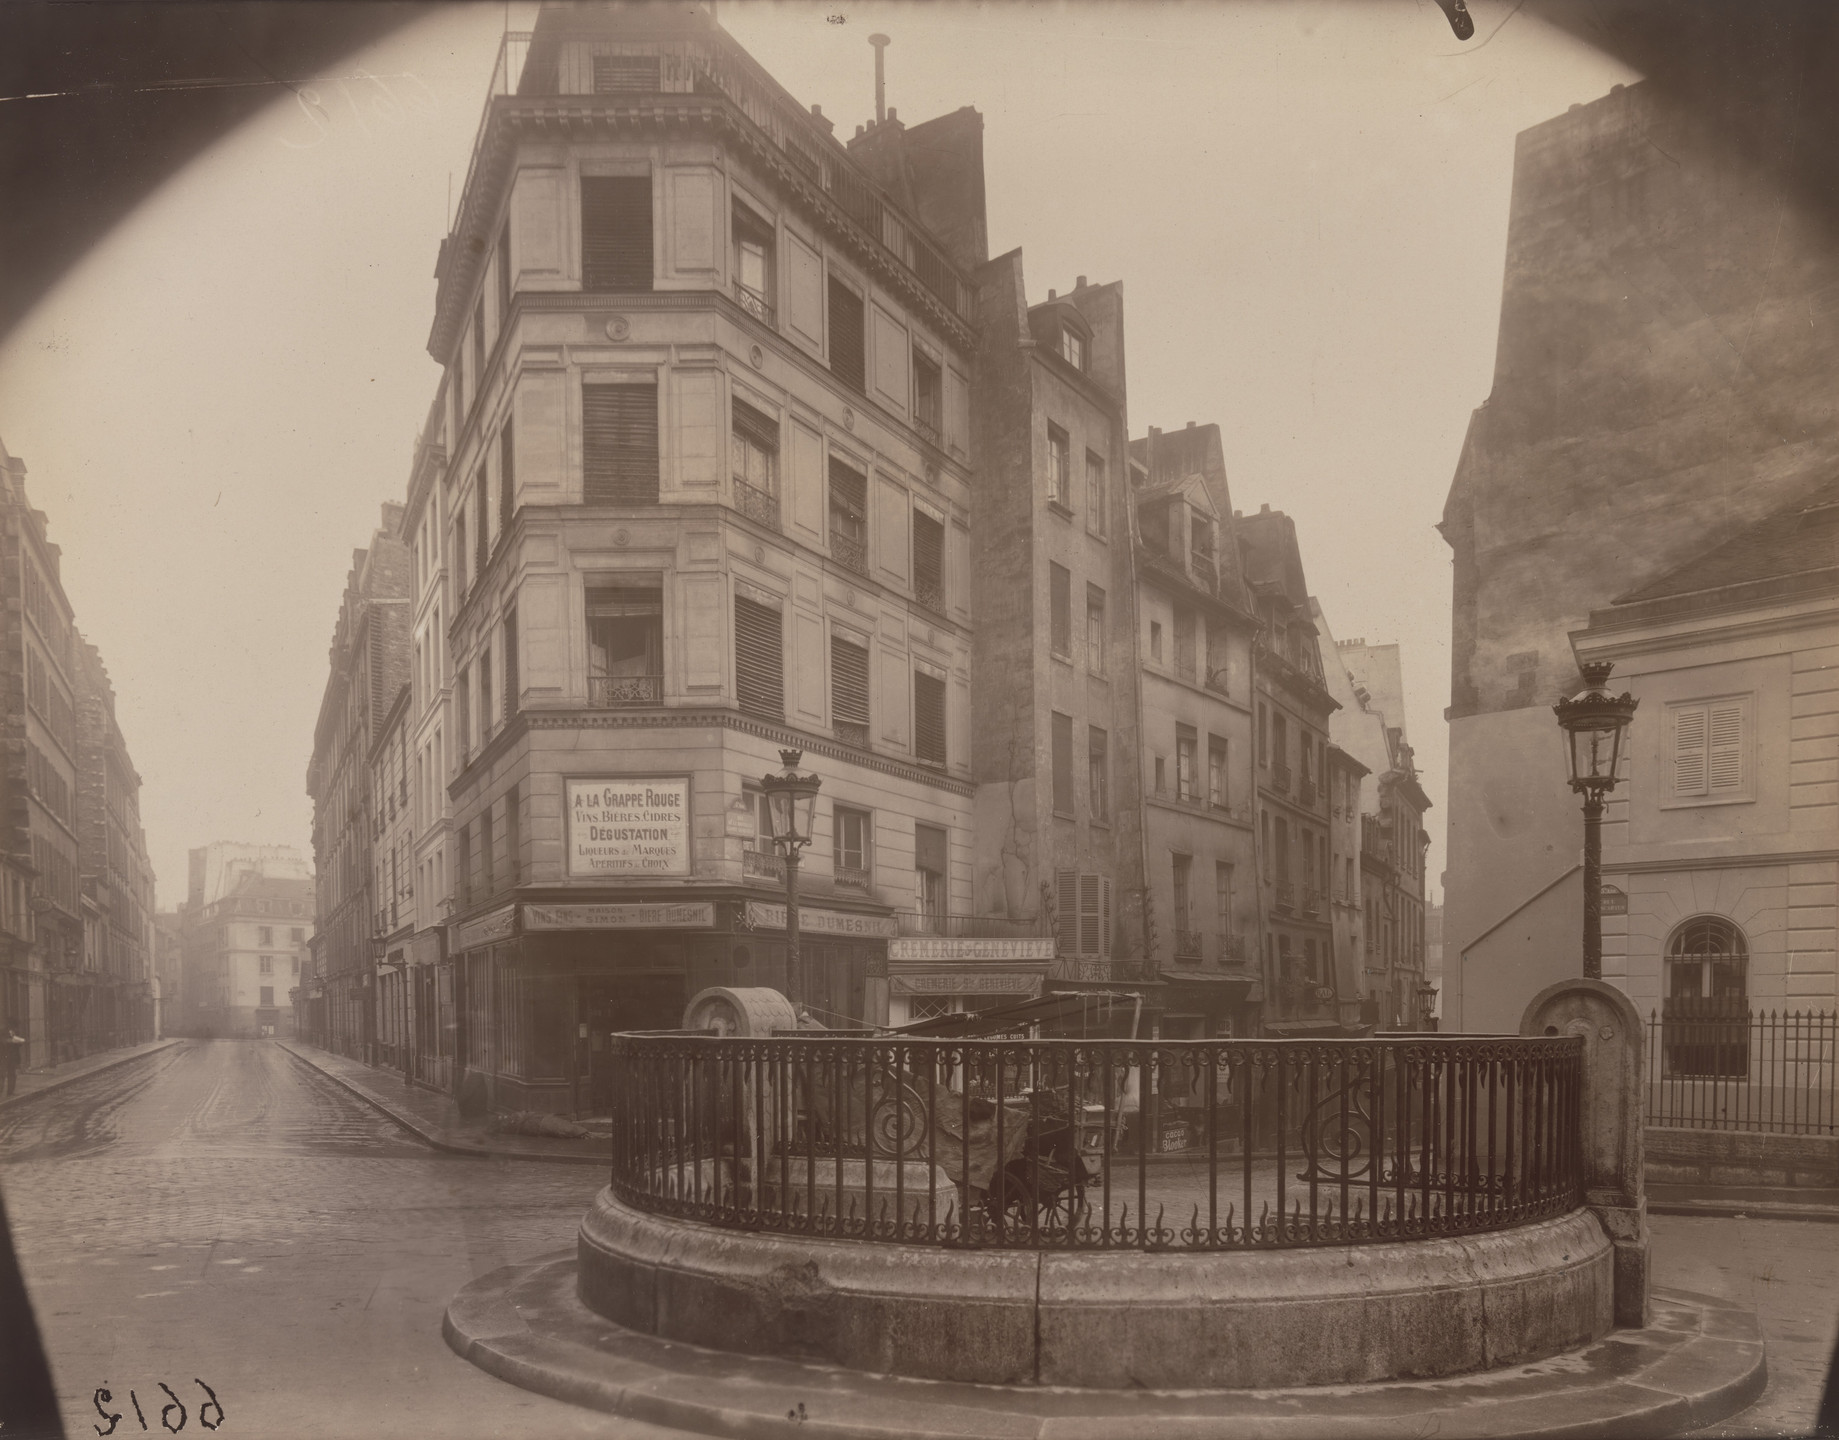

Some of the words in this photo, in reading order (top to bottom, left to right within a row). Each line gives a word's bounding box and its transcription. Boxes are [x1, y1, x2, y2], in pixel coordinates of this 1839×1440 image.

[587, 794, 600, 808] LA
[603, 788, 644, 807] GRAPPE
[645, 788, 681, 807] ROUGE
[643, 810, 681, 822] CIDRES
[579, 844, 619, 855] LIQUEURS
[632, 844, 677, 856] MARQUES
[642, 856, 670, 870] CHOIX
[588, 906, 623, 914] MAISON
[585, 914, 627, 924] SIMON
